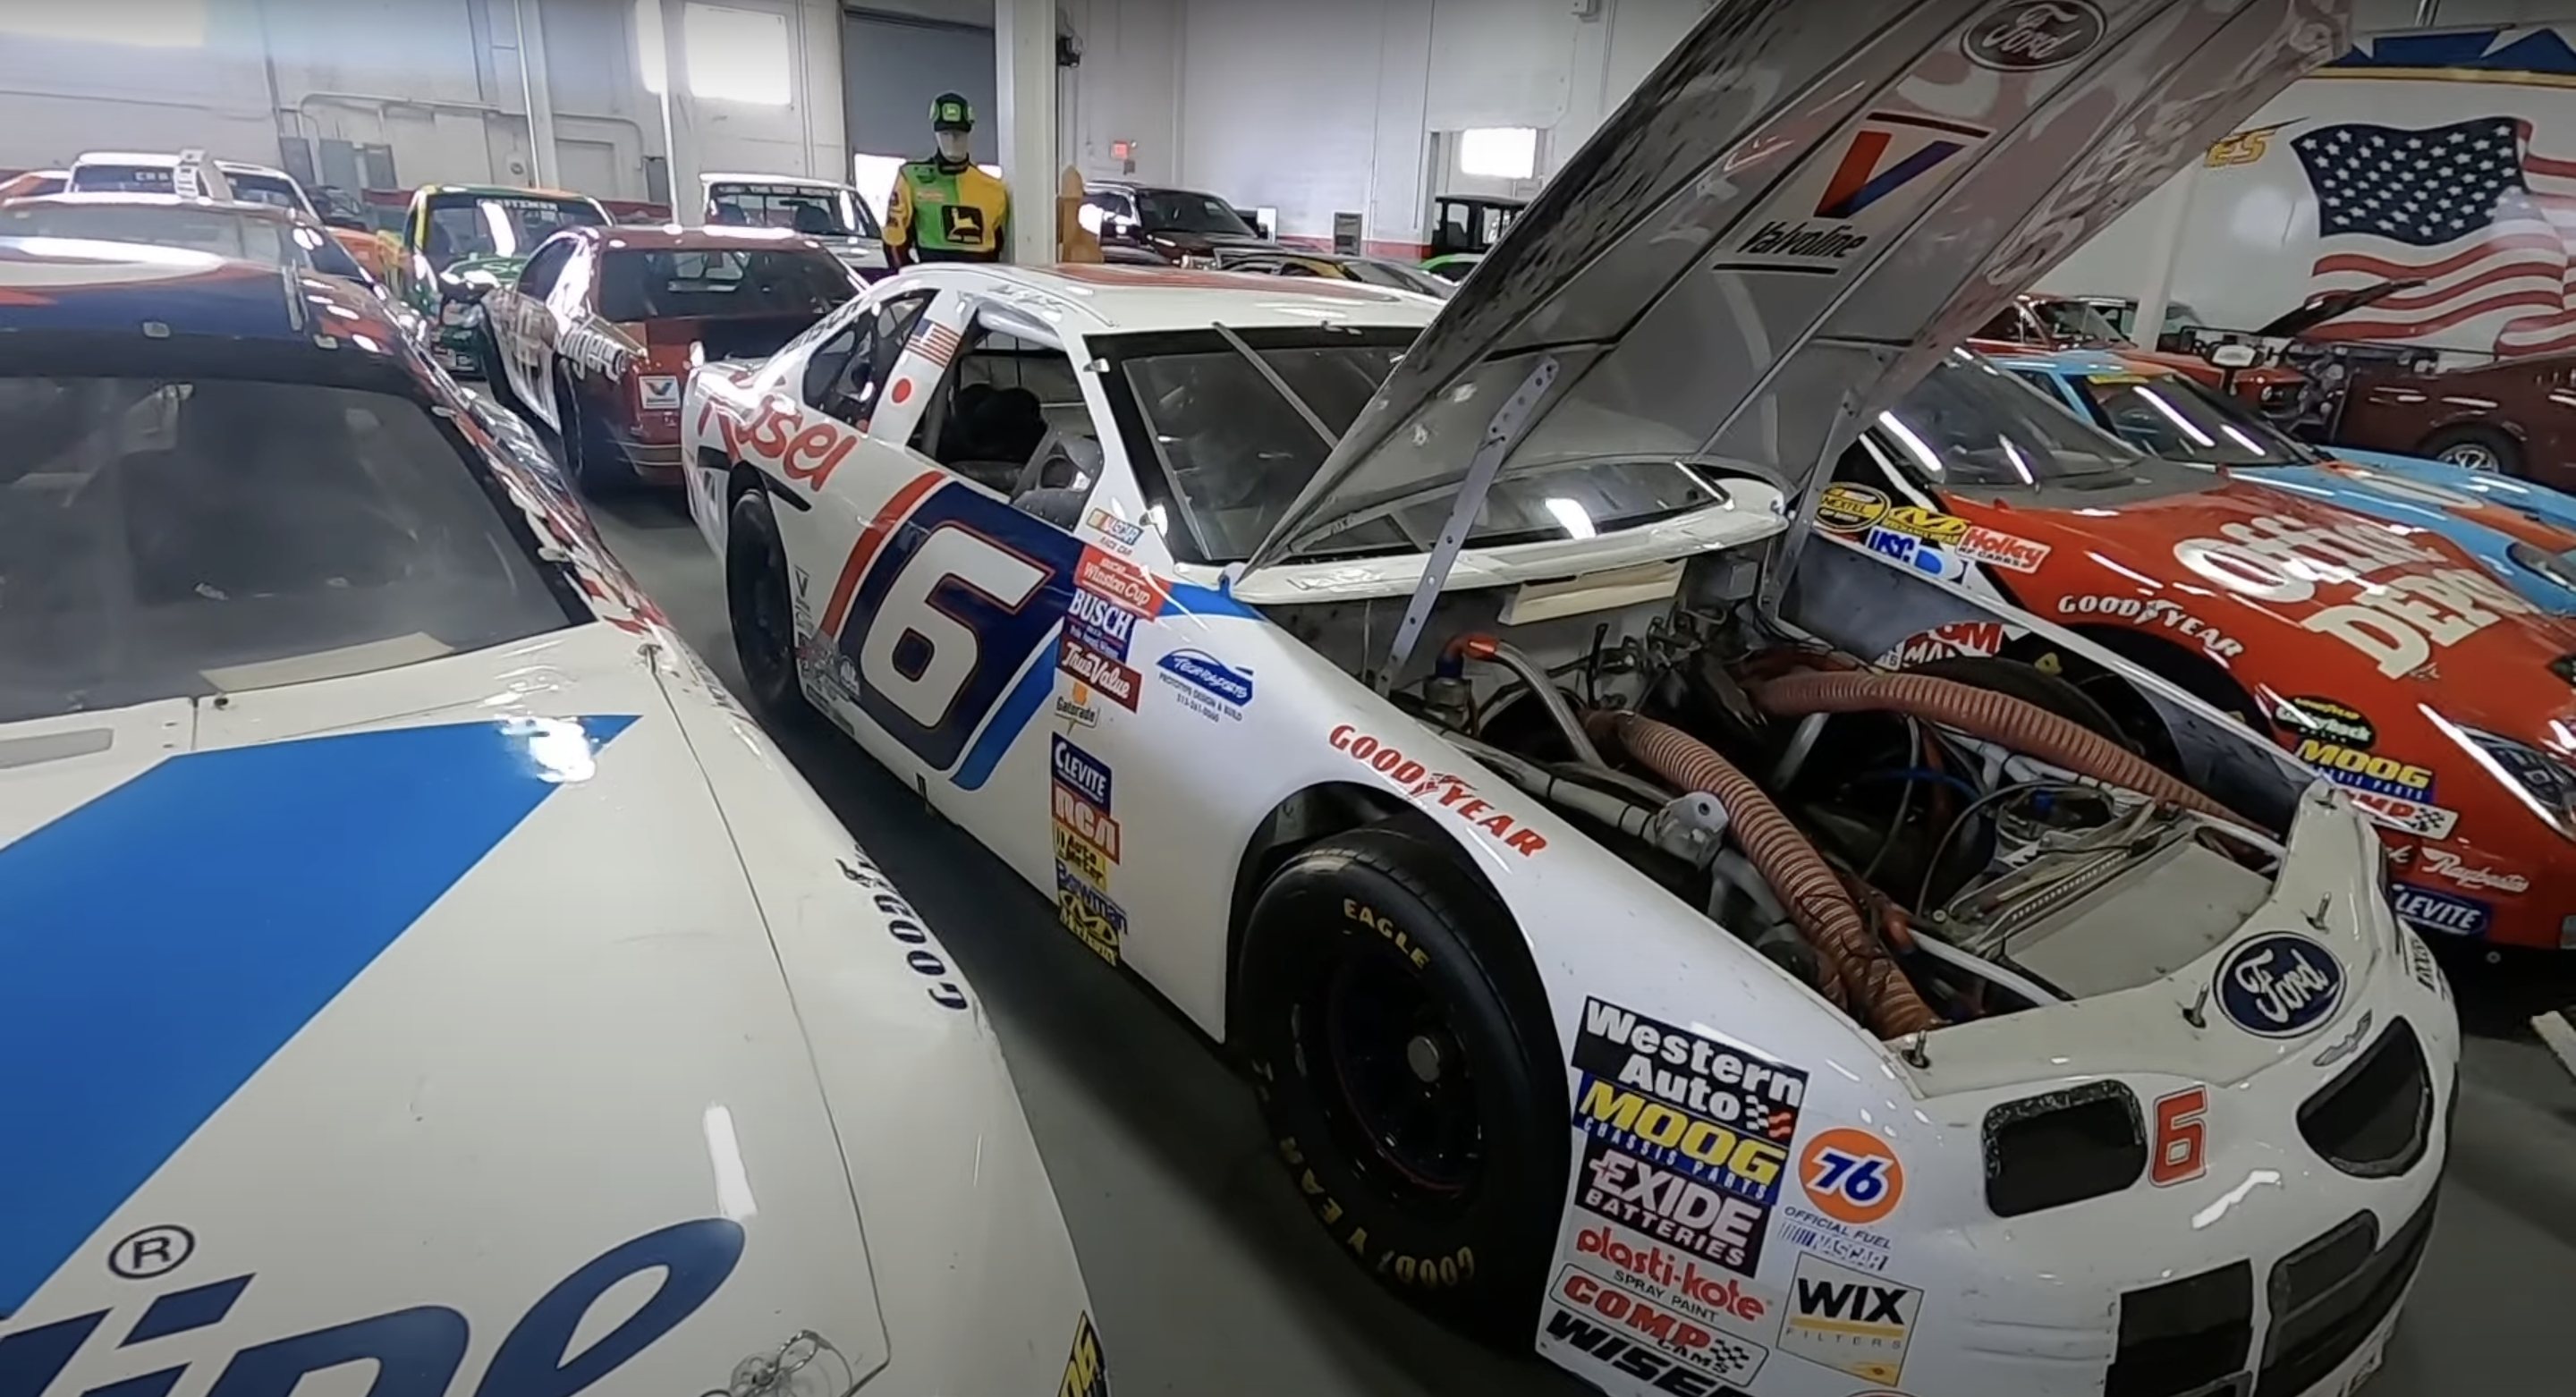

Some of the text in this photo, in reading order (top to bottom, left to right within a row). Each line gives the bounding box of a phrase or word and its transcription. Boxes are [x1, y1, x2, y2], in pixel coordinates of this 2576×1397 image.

[1981, 3, 2081, 59] Ford
[1737, 220, 1868, 258] Valvoline
[1966, 528, 2045, 568] Holley
[1068, 588, 1135, 640] BUSCH
[1083, 562, 1150, 606] Winston Cup
[860, 521, 1055, 730] 6
[2059, 595, 2243, 658] GOODYEAR
[2300, 569, 2545, 679] DEPO
[1055, 741, 1107, 797] CLEVITE
[1329, 724, 1547, 857] GOODYEAR
[2295, 739, 2433, 789] MOOG
[1055, 785, 1115, 856] RCA
[1343, 898, 1429, 969] EAGLE
[2236, 949, 2329, 1024] Ford
[1587, 1000, 1803, 1106] Western
[1618, 1054, 1741, 1121] Auto
[1579, 1080, 1787, 1185] MOOG
[1583, 1120, 1767, 1199] CHASSIS PARTS
[2148, 1085, 2208, 1188] 6
[1589, 1148, 1762, 1249] EXIDE
[1809, 1148, 1891, 1206] 76
[1585, 1189, 1746, 1266] BATTERIES
[1784, 1206, 1892, 1249] OFFICIAL FUEL
[1576, 1225, 1764, 1321] plasti-kote
[1614, 1270, 1719, 1323] SPRAY PAINT
[1798, 1277, 1908, 1325] WIX
[1563, 1274, 1711, 1348] COMP
[1786, 1327, 1902, 1350] FILTERS
[1546, 1309, 1755, 1397] WISE
[1657, 1339, 1731, 1374] CAMS
